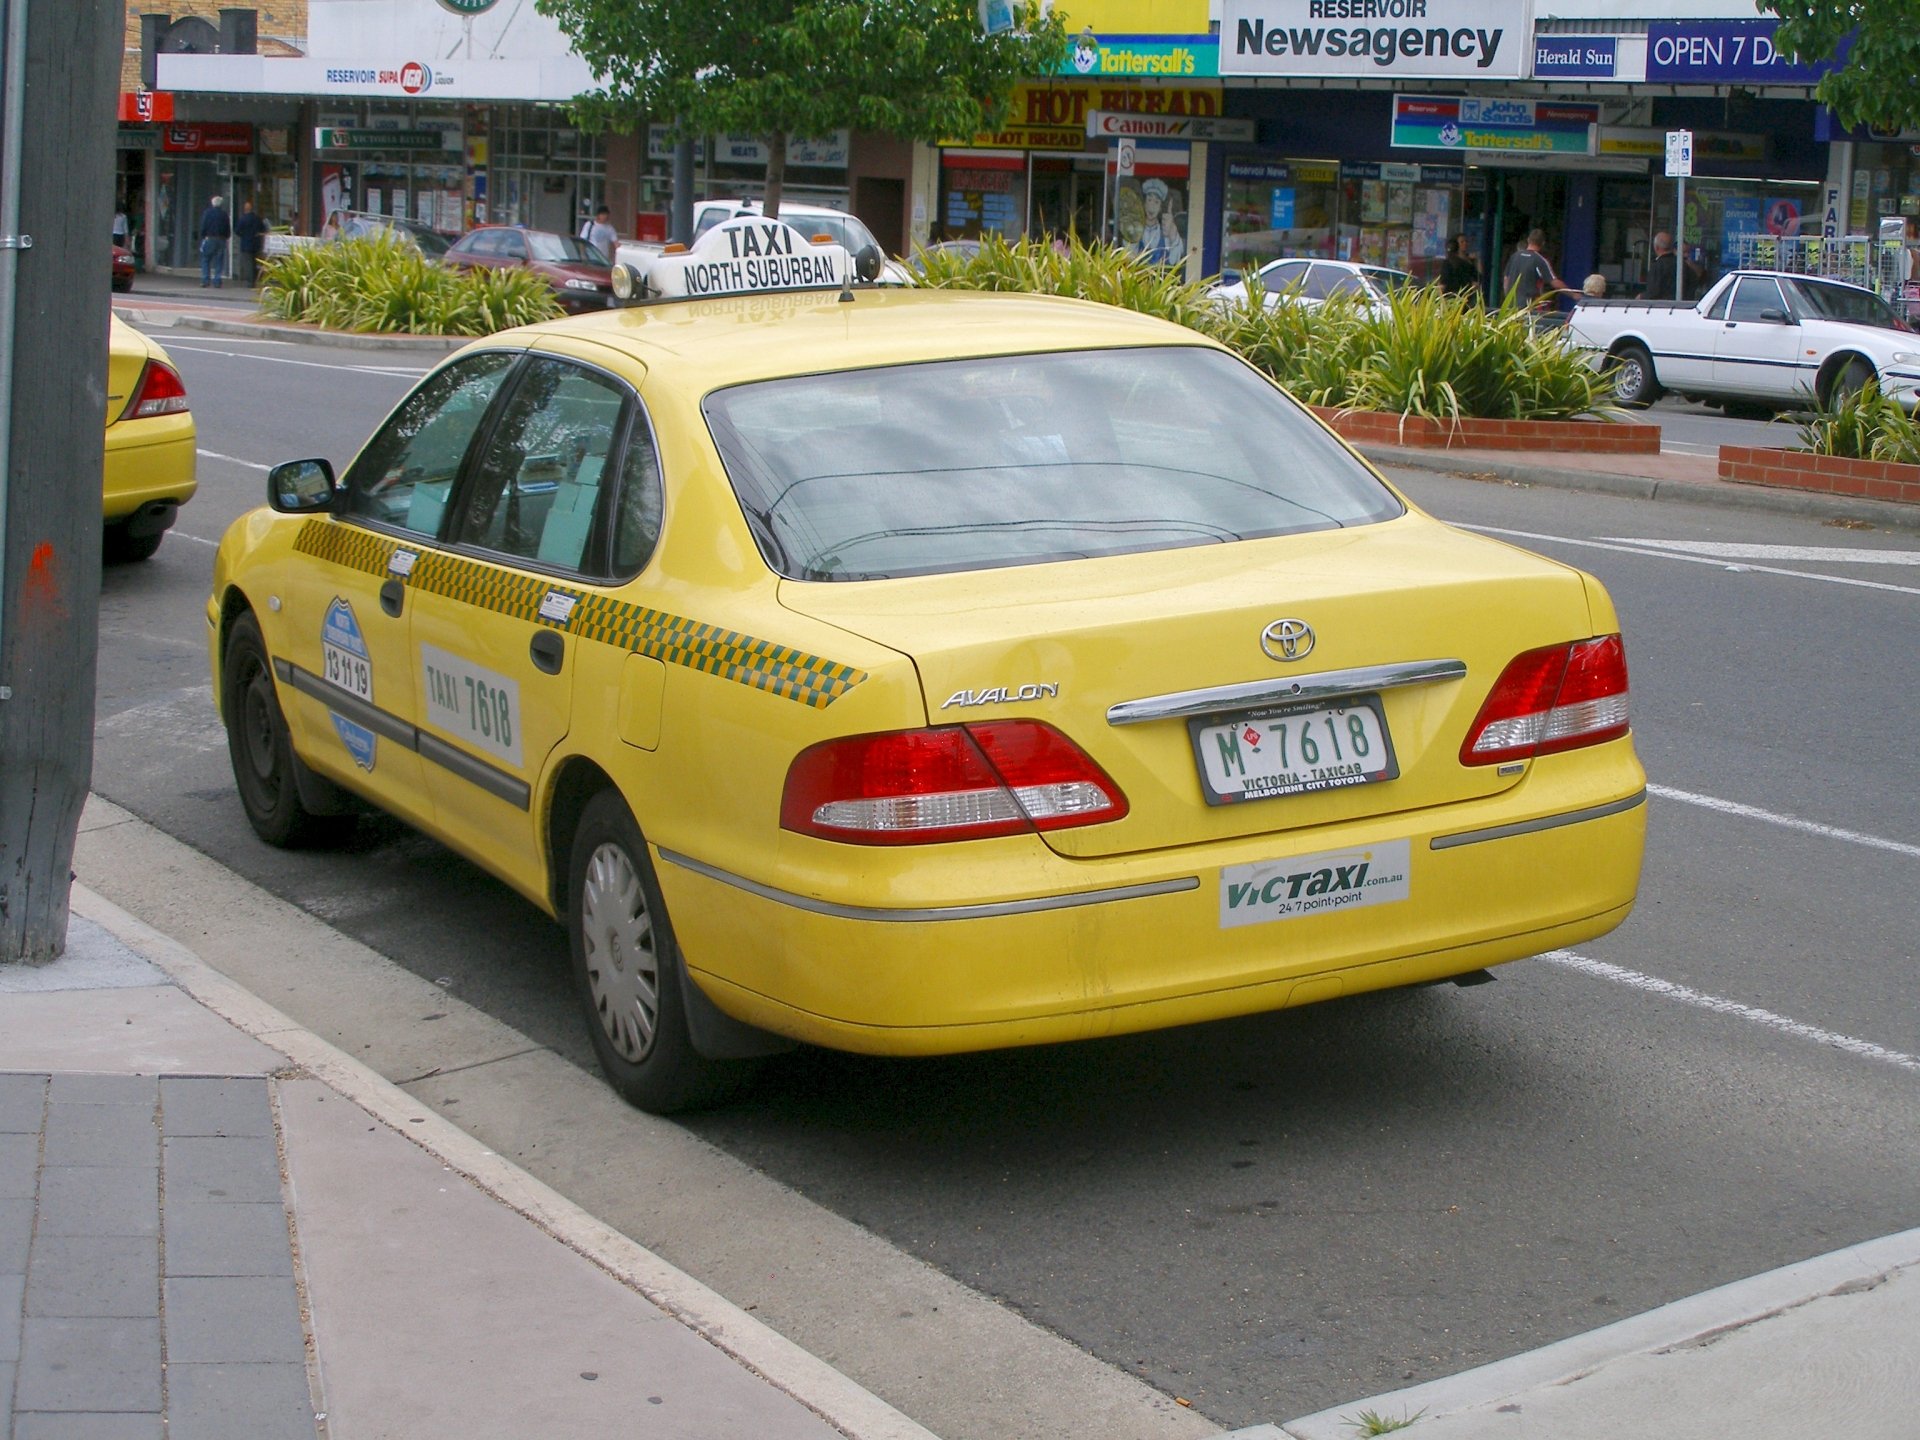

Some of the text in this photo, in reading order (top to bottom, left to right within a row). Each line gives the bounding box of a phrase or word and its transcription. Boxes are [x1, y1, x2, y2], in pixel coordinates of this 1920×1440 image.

[1309, 0, 1426, 18] RESERVOIR
[1236, 18, 1504, 68] Newsagency
[1654, 36, 1723, 65] OPEN
[1732, 37, 1746, 65] 7
[1099, 47, 1195, 74] Tattersall's
[1536, 49, 1613, 65] Herald Sun
[327, 68, 422, 87] RESERVOIR SUPA IGA
[1026, 89, 1217, 124] HOT BREAD
[1407, 104, 1439, 113] Reservoir
[1485, 100, 1527, 114] John
[1103, 115, 1168, 135] Canon
[1479, 110, 1533, 124] Sands
[352, 134, 398, 144] VICTORIA
[1028, 131, 1082, 146] BREAD
[1464, 130, 1553, 149] Tattersall's
[1683, 135, 1689, 146] P
[730, 145, 758, 158] MEATS
[1229, 163, 1264, 176] Reservoir
[1266, 165, 1288, 178] News
[1725, 210, 1759, 219] DIVISION
[722, 224, 793, 258] TAXI
[684, 255, 836, 295] NORTH SUBURBAN
[327, 649, 368, 695] 13 11 19
[941, 681, 1059, 709] AVALON
[427, 665, 513, 748] TAXI 7618
[1242, 771, 1300, 791] VICTORIA
[1310, 762, 1363, 780] TAXICAB
[1244, 774, 1367, 800] MELBOURNE CITY TOYOTA
